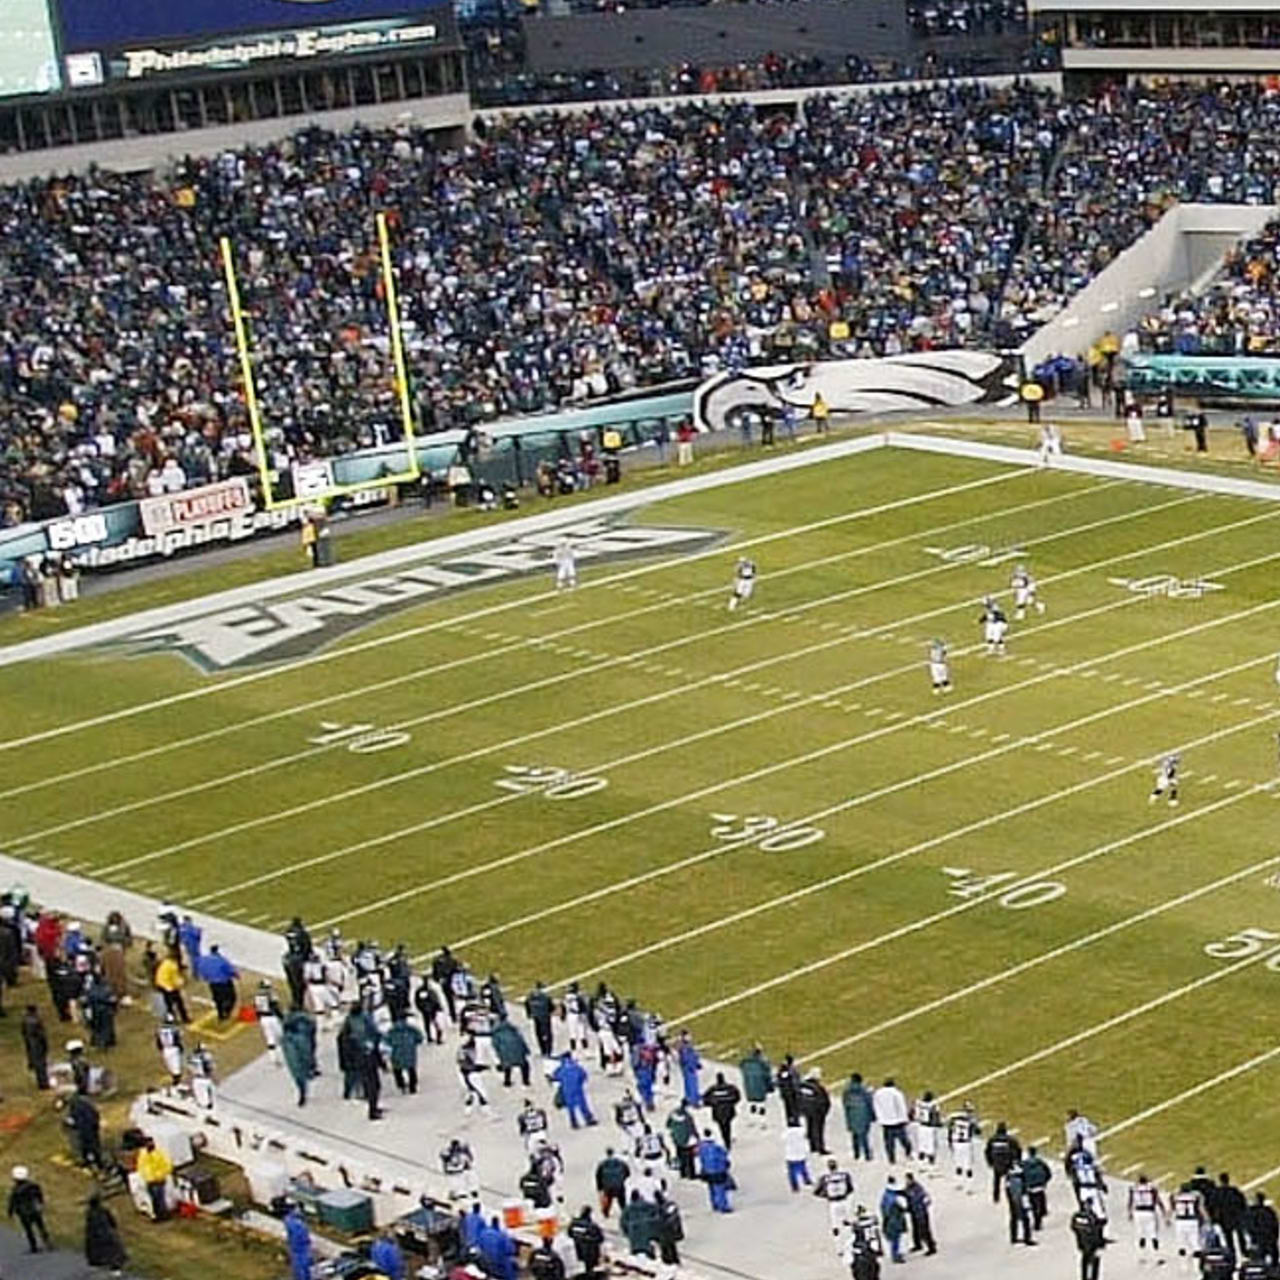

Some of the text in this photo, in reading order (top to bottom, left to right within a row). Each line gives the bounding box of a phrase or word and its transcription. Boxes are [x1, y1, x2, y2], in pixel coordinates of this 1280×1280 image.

[128, 517, 722, 667] EAGLES
[711, 816, 825, 852] 30
[945, 869, 1067, 910] 40
